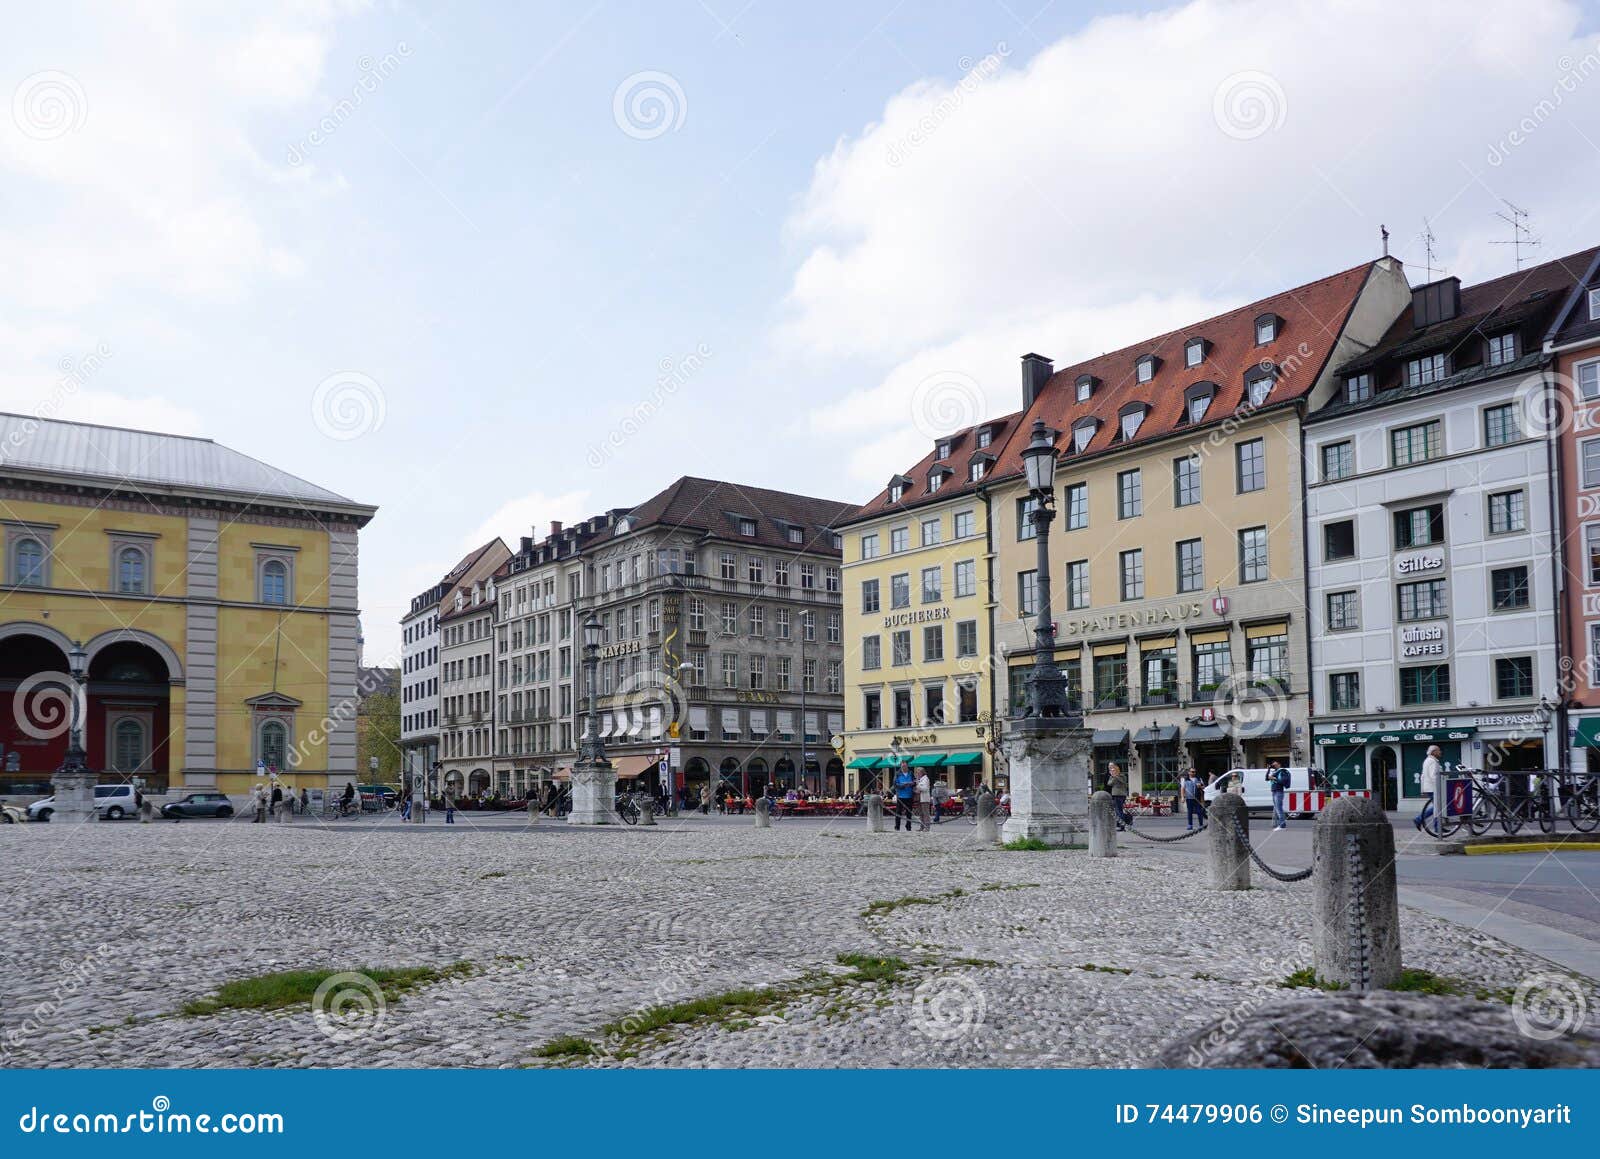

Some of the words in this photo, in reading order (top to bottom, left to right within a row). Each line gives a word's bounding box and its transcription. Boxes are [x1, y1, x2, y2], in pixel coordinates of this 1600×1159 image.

[885, 607, 951, 628] BUCHERER
[1068, 603, 1202, 635] SPATENHAUS
[600, 641, 640, 659] MAYSER
[1402, 643, 1444, 657] KAFFEE
[1333, 723, 1358, 734] TEE
[1400, 717, 1448, 731] KAFFEE
[1473, 715, 1503, 727] EILLES
